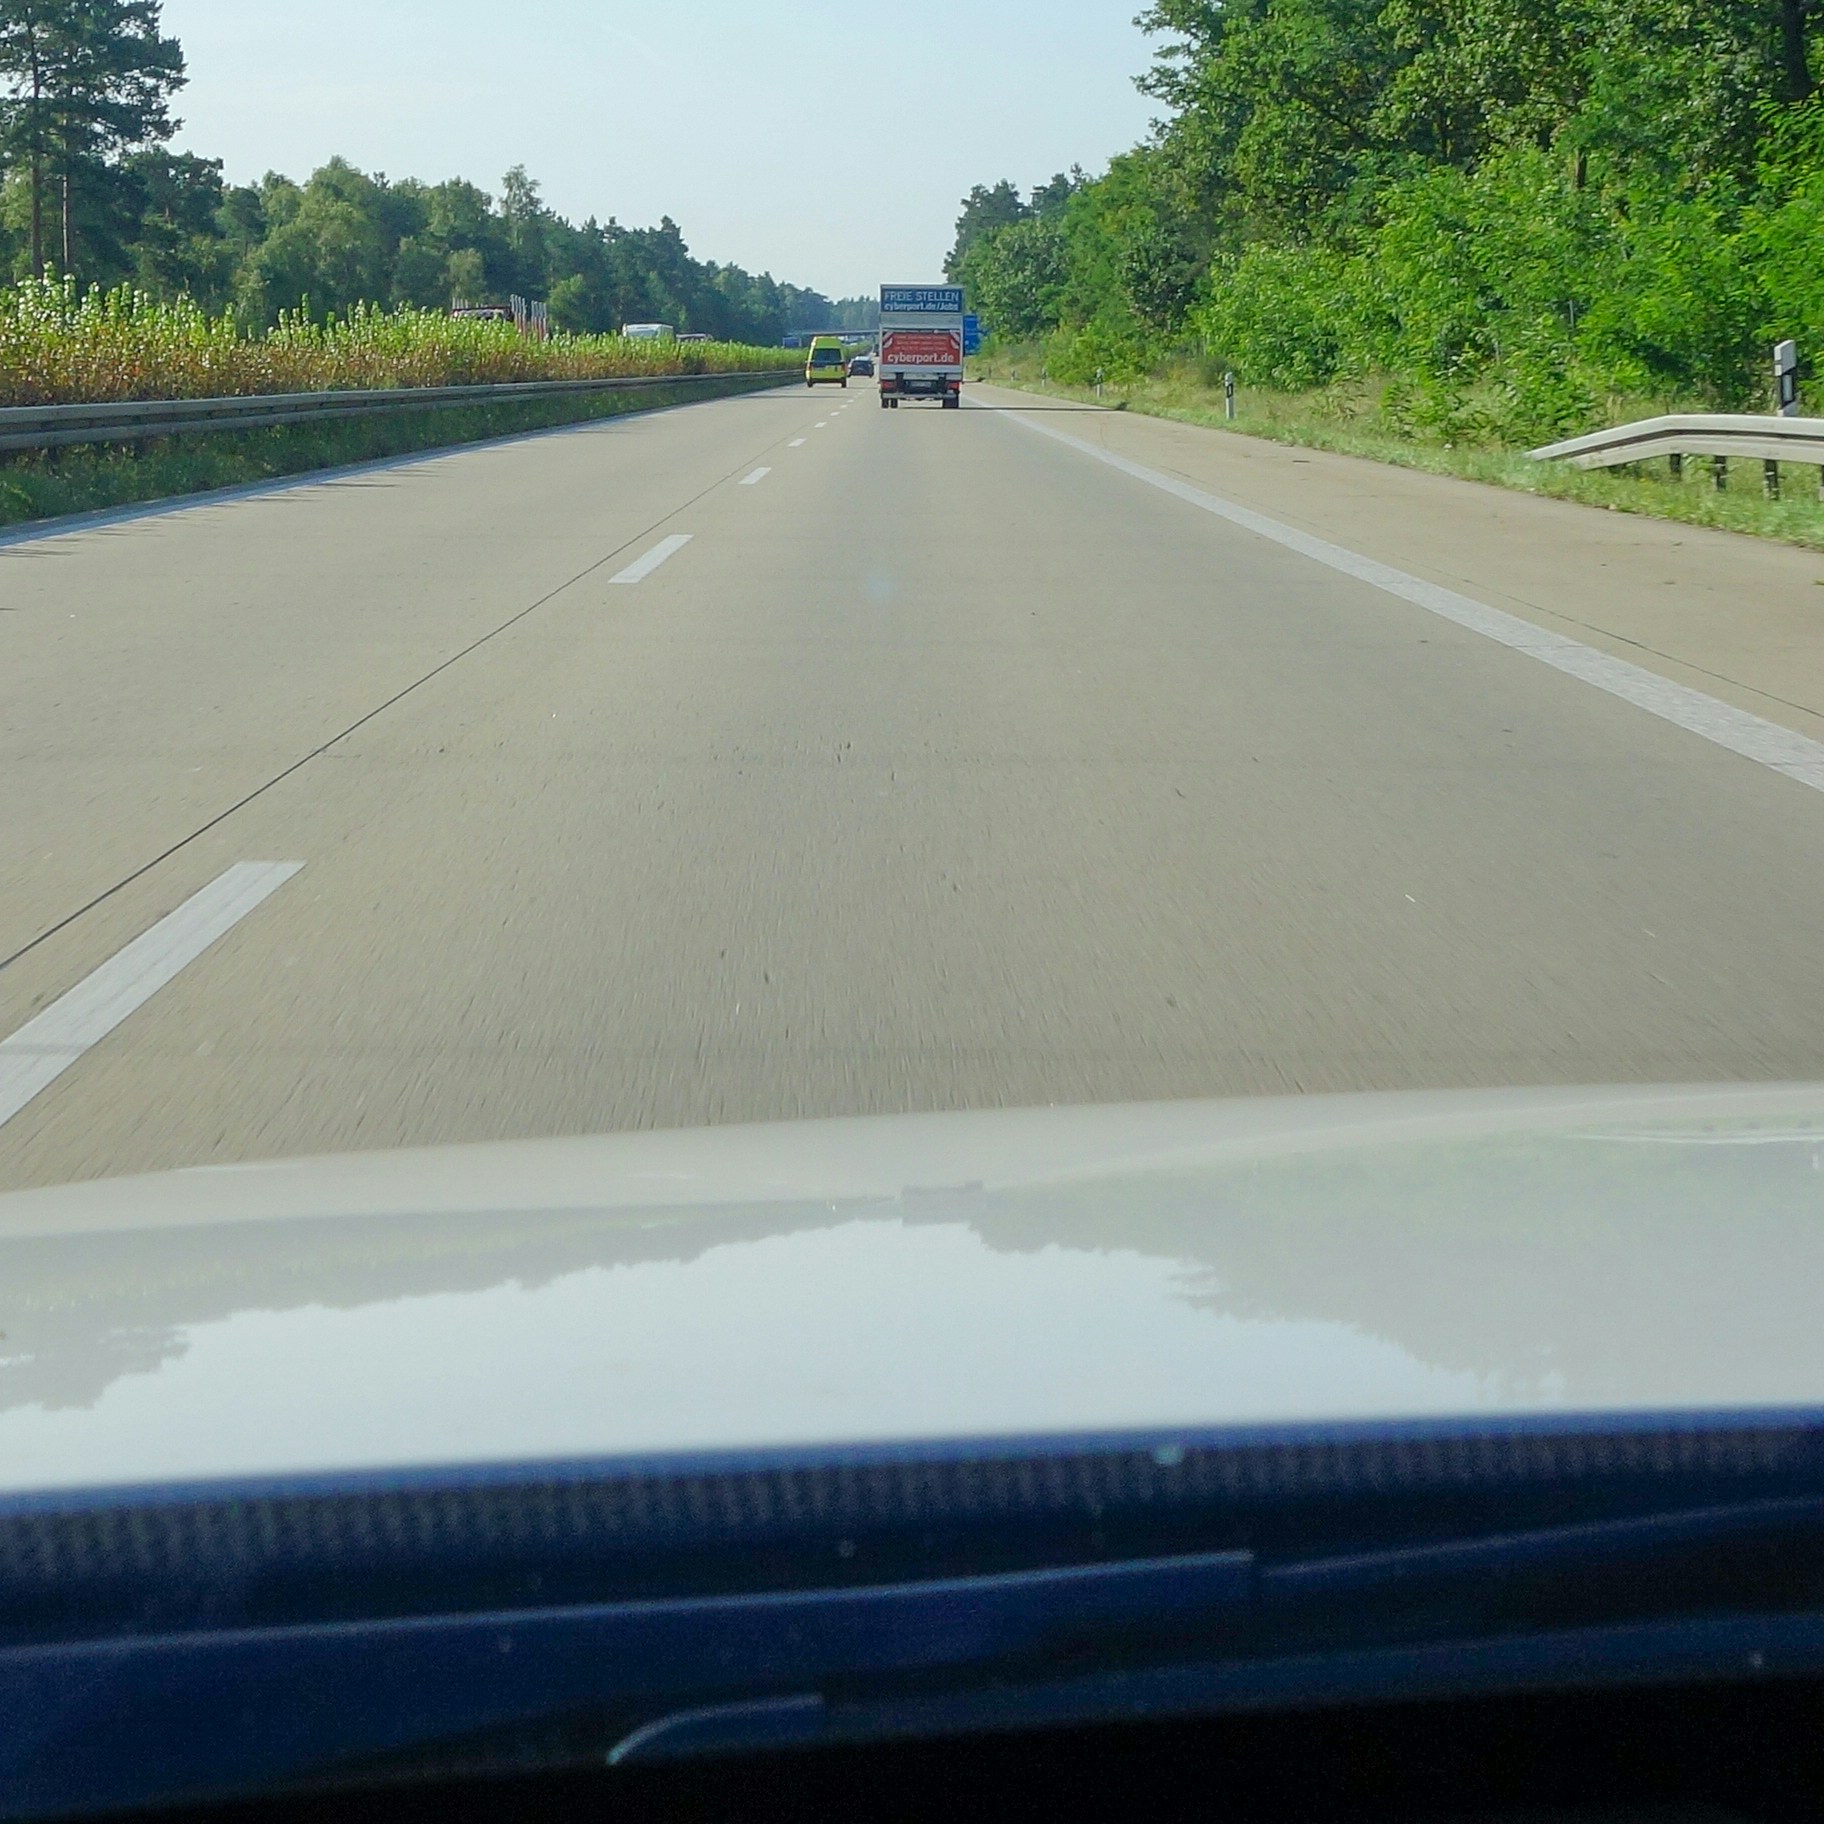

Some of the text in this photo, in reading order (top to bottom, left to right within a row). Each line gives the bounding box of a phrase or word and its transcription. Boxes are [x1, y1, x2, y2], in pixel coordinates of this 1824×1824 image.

[884, 291, 959, 302] FREIE STELLEN
[887, 352, 955, 364] cyberport.de
